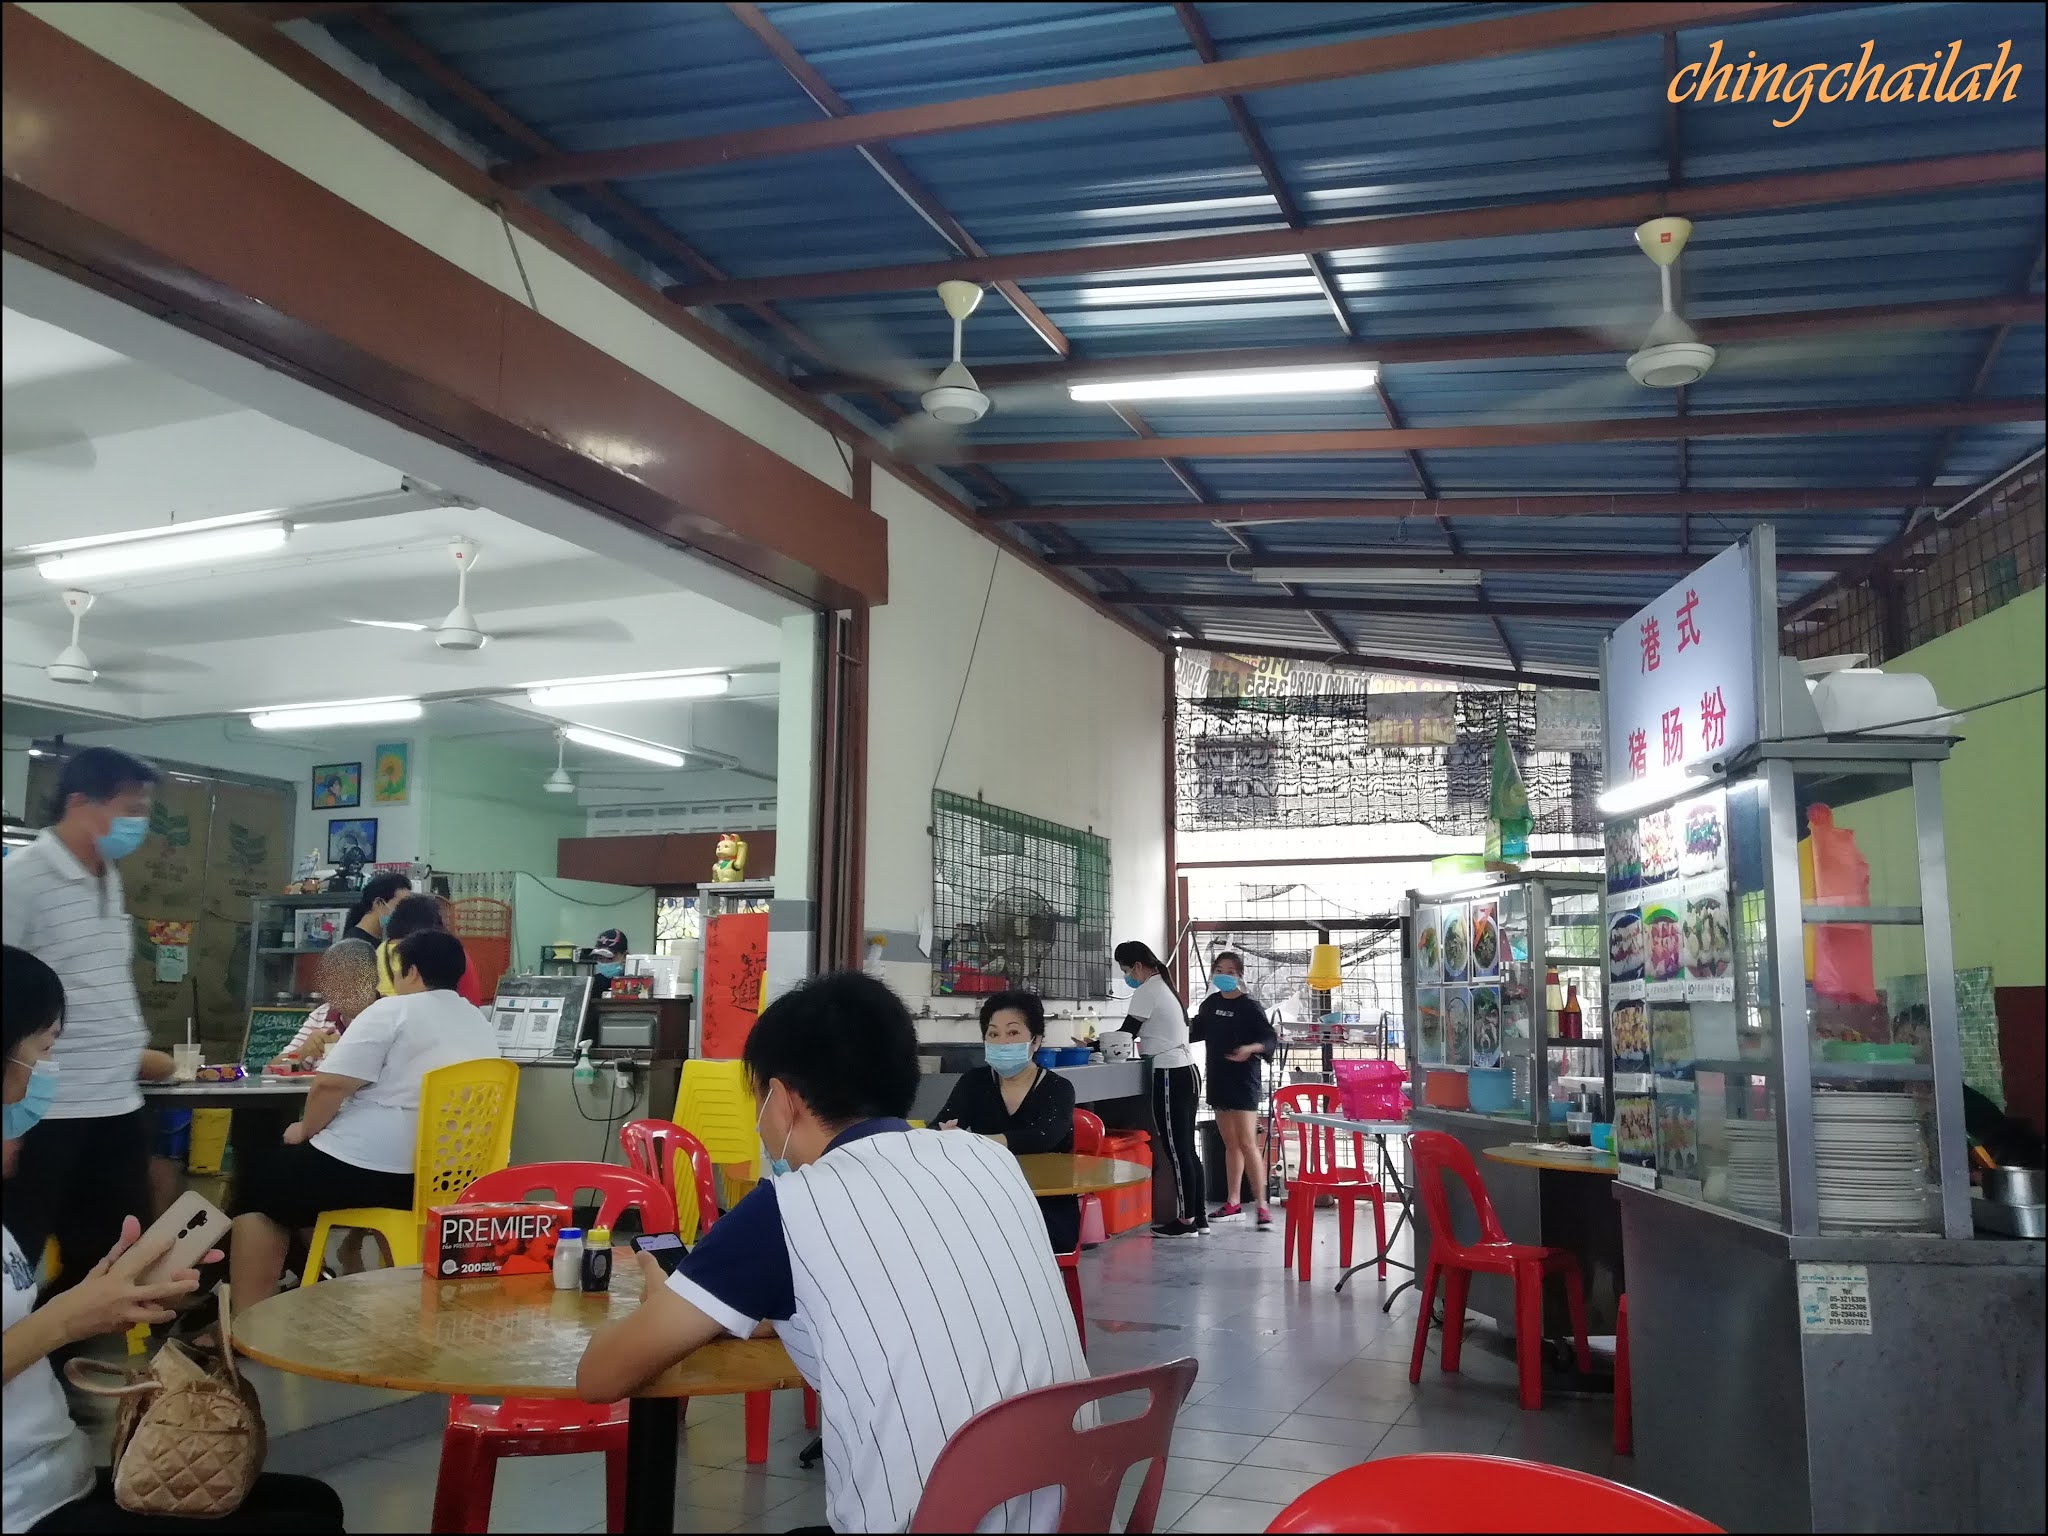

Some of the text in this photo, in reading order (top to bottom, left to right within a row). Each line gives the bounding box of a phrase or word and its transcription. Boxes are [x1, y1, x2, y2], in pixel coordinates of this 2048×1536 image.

[1640, 588, 1700, 675] 港式
[1628, 686, 1726, 782] 猪肠粉
[441, 1215, 552, 1243] PREMIER
[461, 1263, 481, 1273] 200
